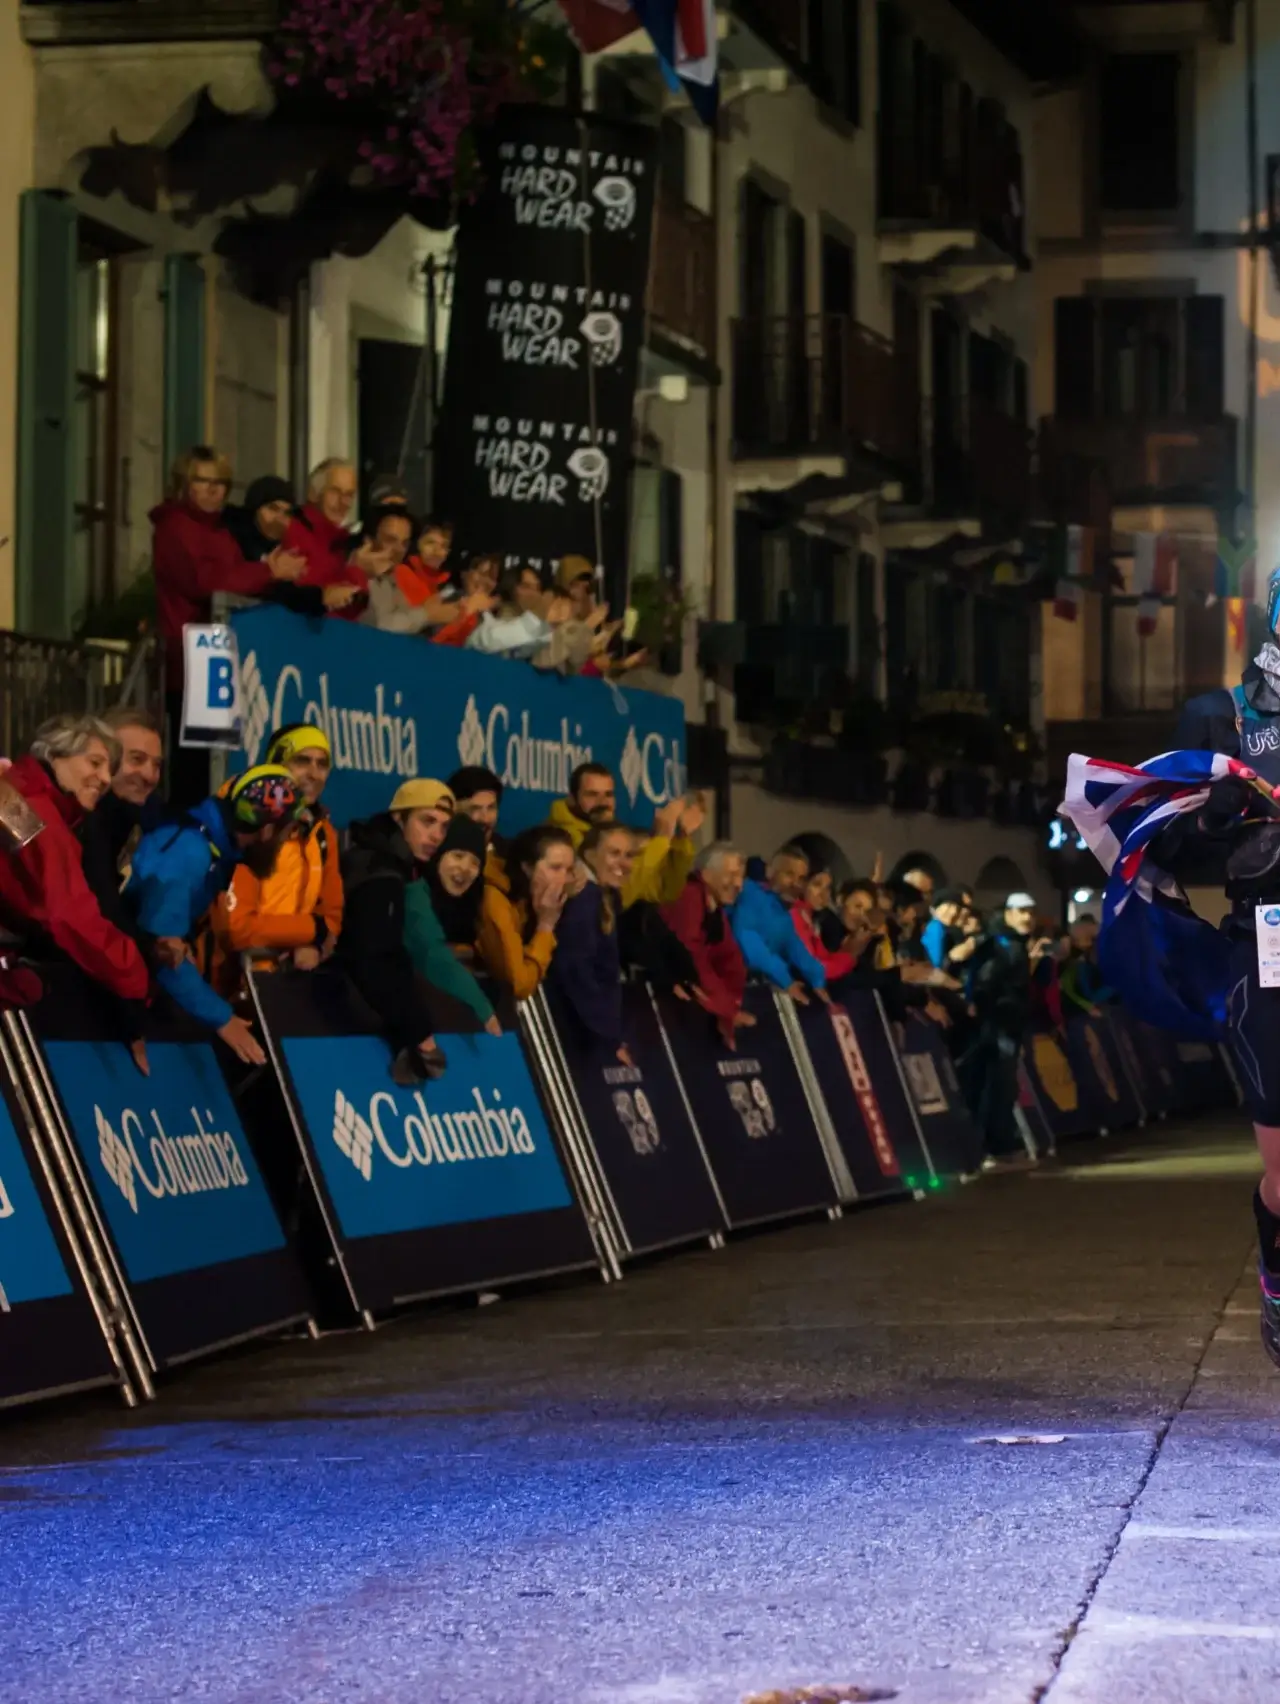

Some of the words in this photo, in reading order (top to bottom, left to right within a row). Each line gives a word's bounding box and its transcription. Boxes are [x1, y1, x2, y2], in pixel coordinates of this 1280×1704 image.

[500, 142, 645, 176] MOUNTAIN
[501, 166, 577, 199] HARD
[515, 197, 594, 233] WEAR
[486, 278, 631, 311] MOUNTAIN
[488, 301, 563, 335] HARD
[501, 333, 580, 369] WEAR
[473, 414, 618, 445] MOUNTAIN
[475, 437, 550, 471] HARD
[488, 469, 567, 505] WEAR
[207, 657, 235, 708] B
[370, 1086, 536, 1169] Columbia
[121, 1106, 249, 1199] Columbia
